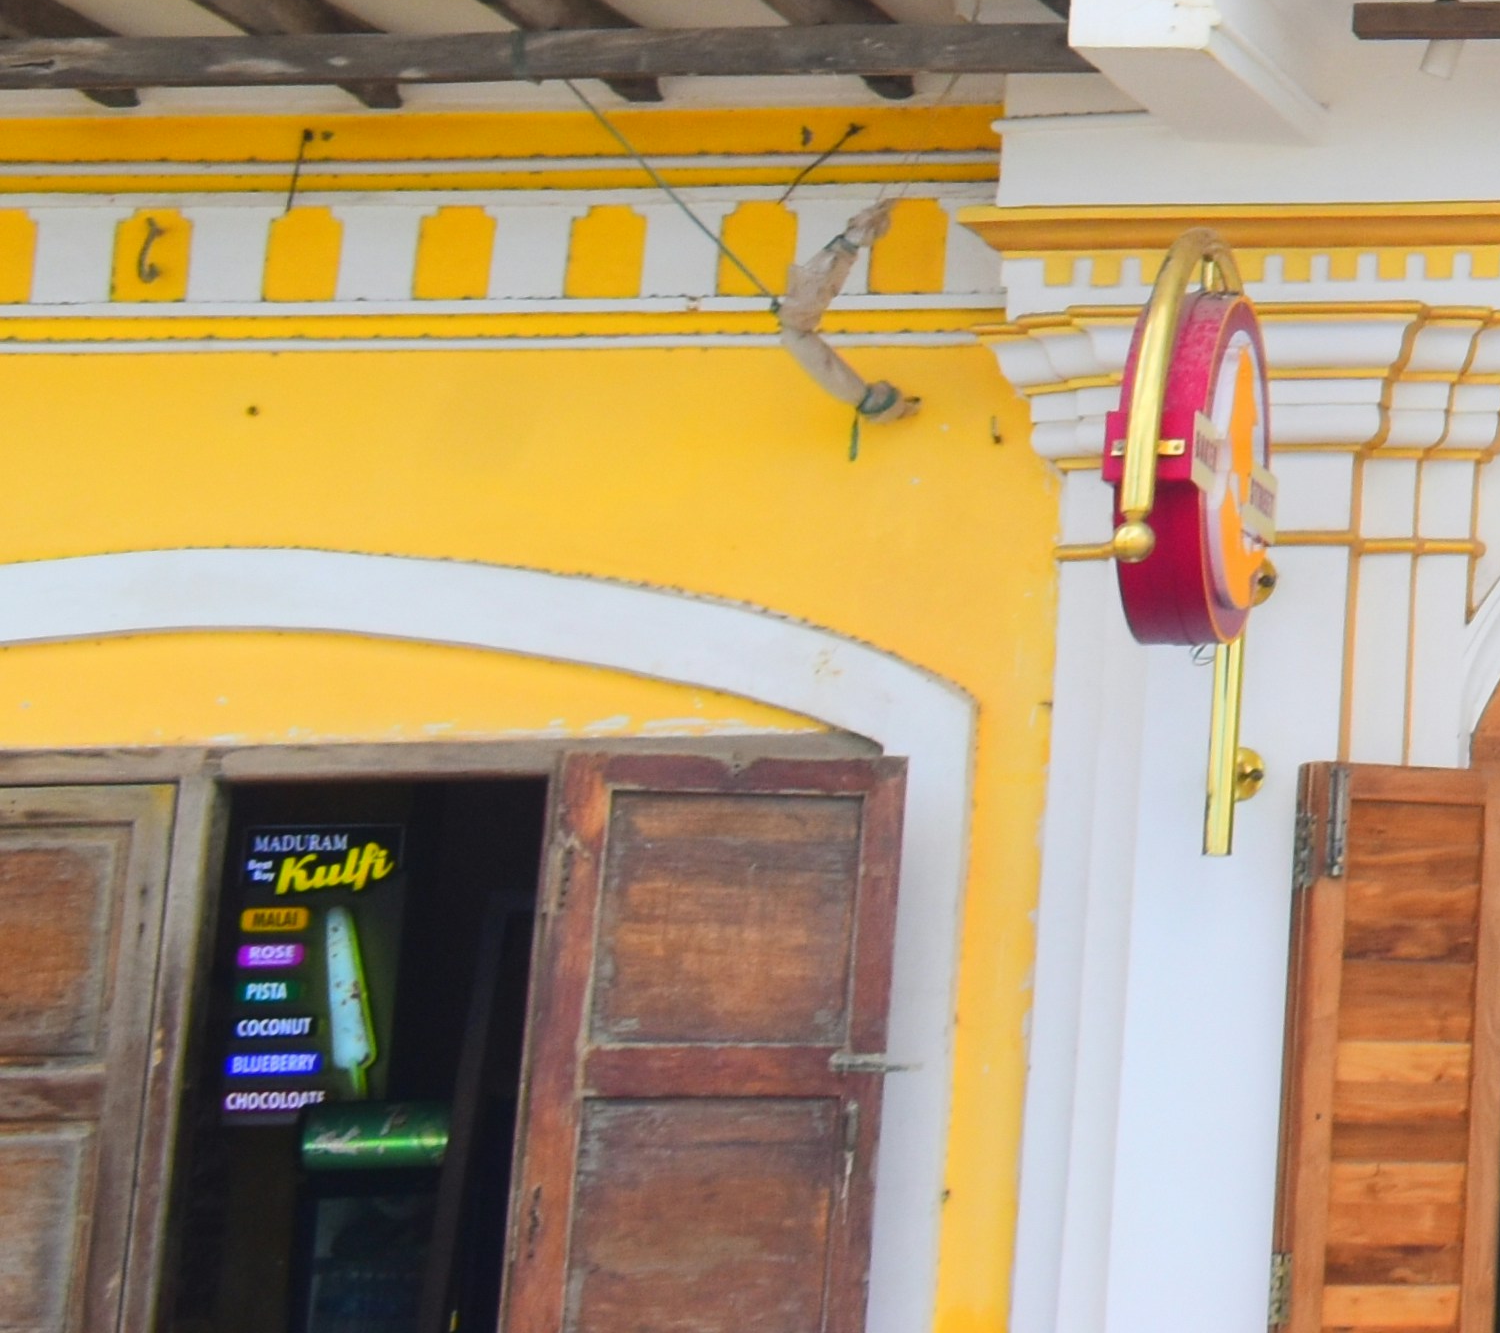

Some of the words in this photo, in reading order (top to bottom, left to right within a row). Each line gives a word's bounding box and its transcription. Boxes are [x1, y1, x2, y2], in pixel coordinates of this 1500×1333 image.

[254, 834, 349, 852] MADURAM
[275, 842, 394, 895] Kulfi
[252, 911, 298, 928] MALAI
[248, 945, 296, 960] ROSE
[245, 982, 288, 1001] PISTA
[236, 1017, 312, 1037] COCONUT
[231, 1053, 317, 1074] BLUEBERRY
